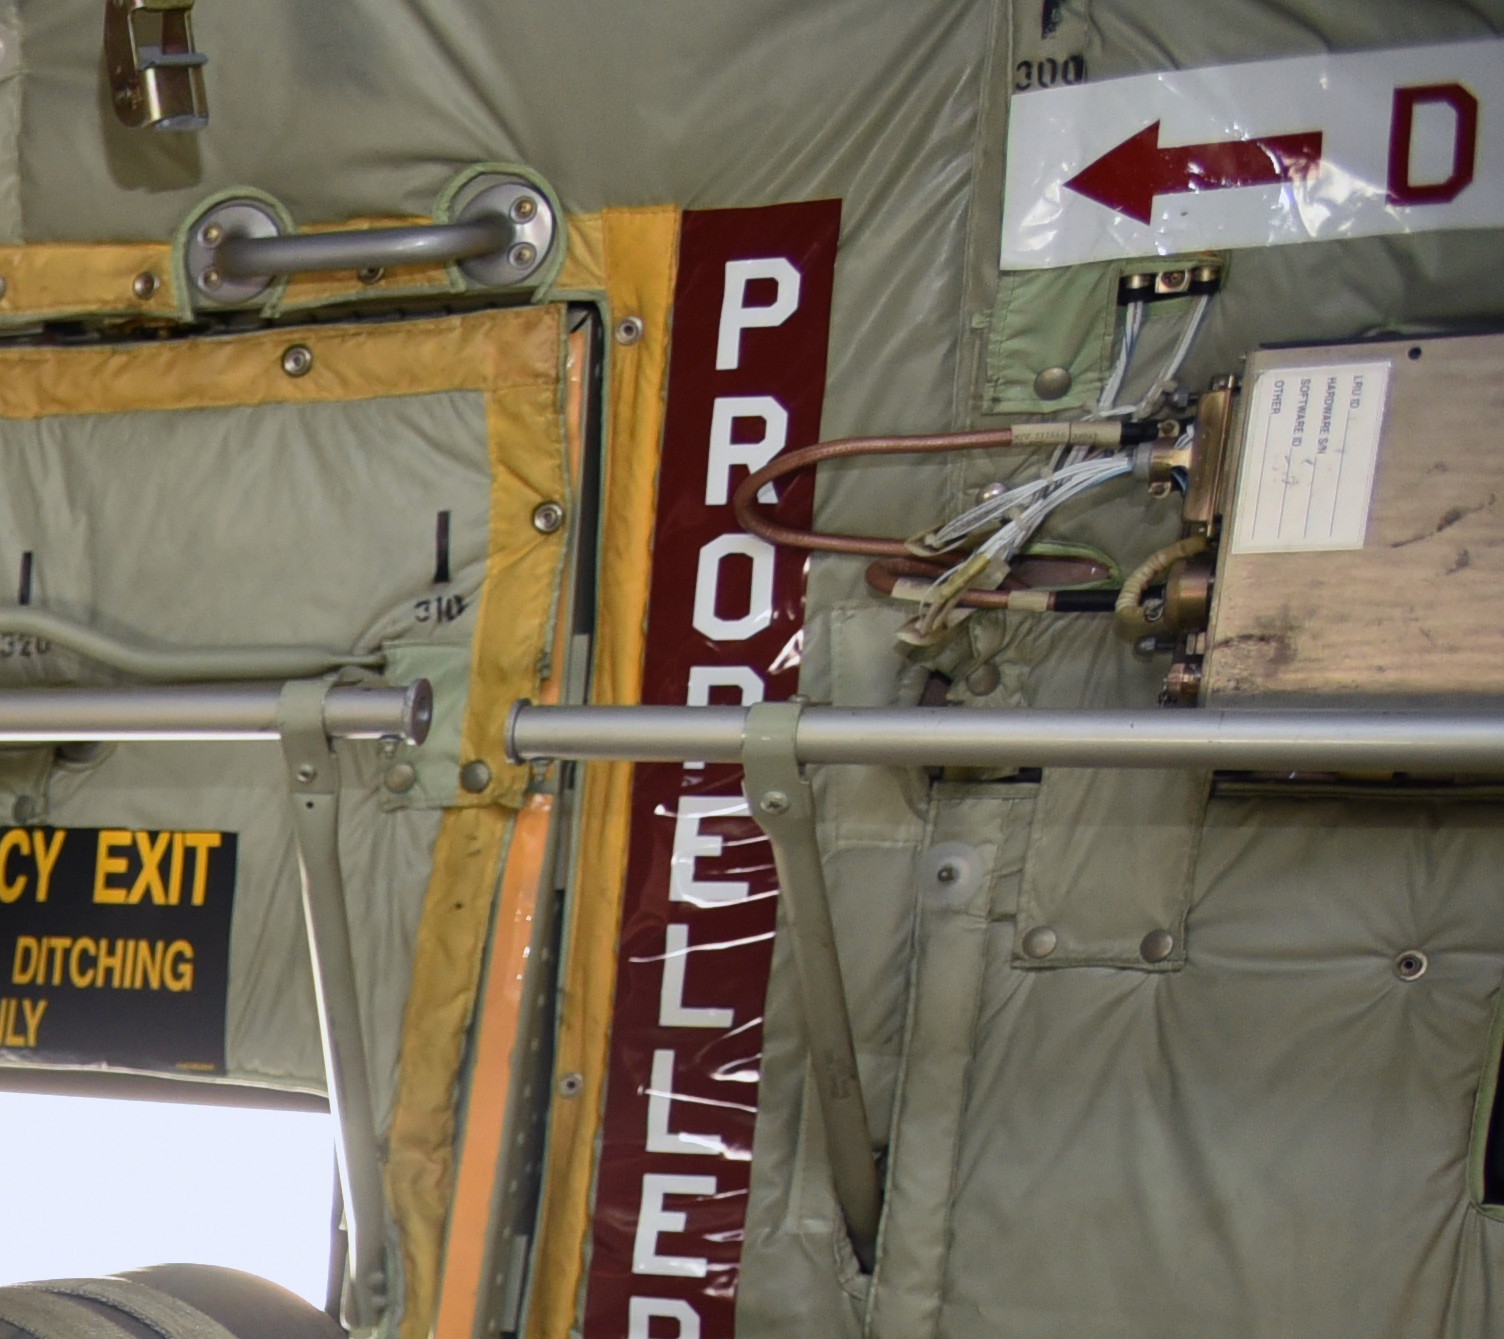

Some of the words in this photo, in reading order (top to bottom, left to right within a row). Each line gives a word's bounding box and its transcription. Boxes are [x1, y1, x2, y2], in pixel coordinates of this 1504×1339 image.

[1385, 83, 1478, 206] D
[1271, 380, 1284, 414] OTHER
[1293, 378, 1311, 433] SOFTWARE
[93, 830, 222, 906] EXIT
[12, 937, 194, 991] DITCHING
